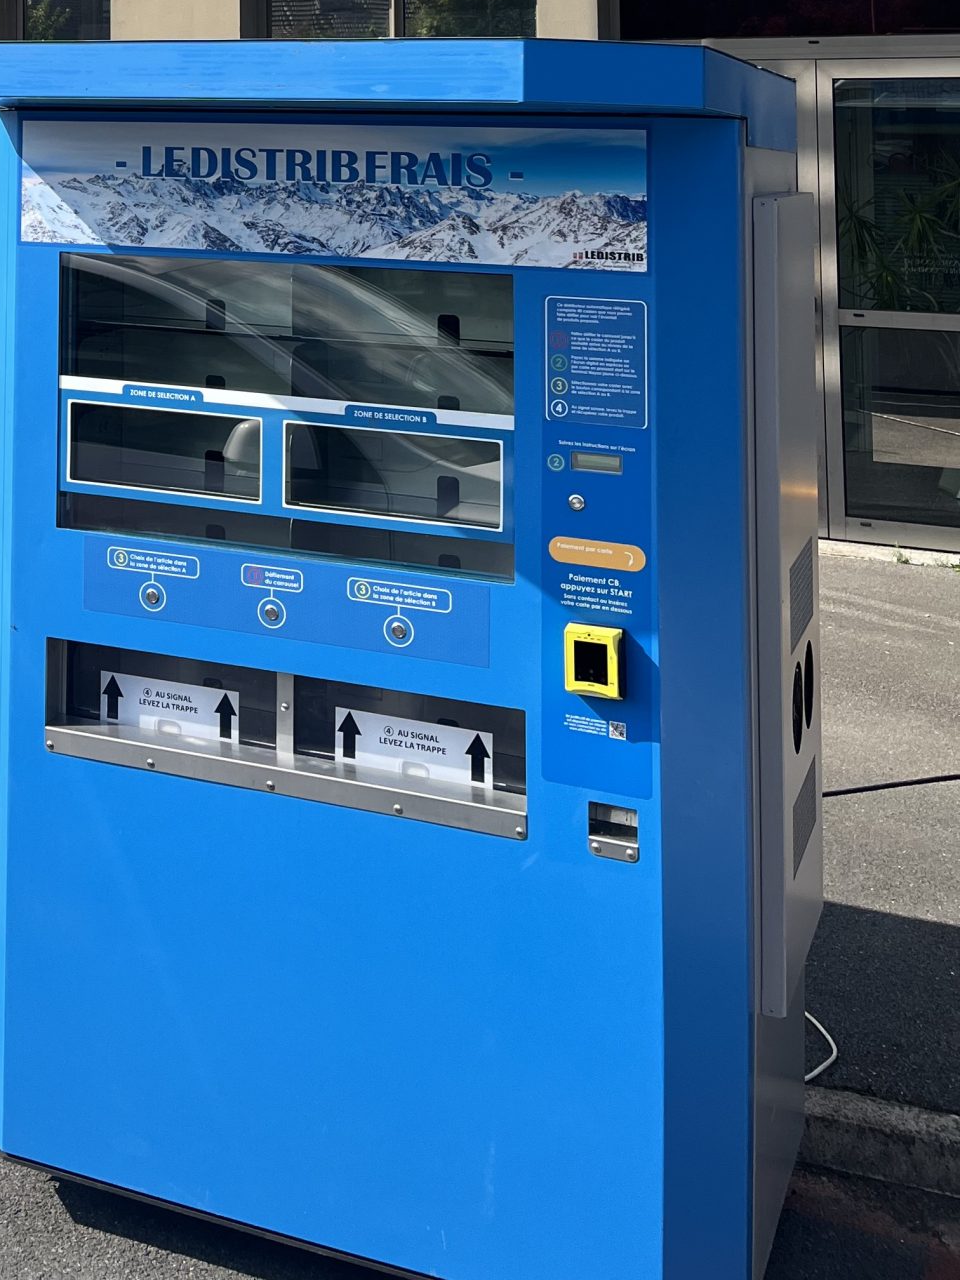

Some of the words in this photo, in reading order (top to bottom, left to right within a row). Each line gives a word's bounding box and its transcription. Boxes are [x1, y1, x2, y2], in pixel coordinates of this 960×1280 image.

[585, 251, 644, 262] LEDISTRIB
[130, 389, 146, 397] ZONE
[157, 392, 189, 400] SELECTION
[353, 410, 372, 418] ZONE
[385, 413, 420, 422] SELECTION
[568, 573, 606, 585] Paiement
[373, 585, 389, 593] Choix
[423, 592, 437, 600] dans
[560, 583, 595, 593] appuyez
[596, 587, 608, 595] sur
[610, 589, 632, 598] START
[167, 692, 192, 703] SIGNAL
[139, 698, 160, 708] LEVEZ
[171, 703, 198, 714] TRAPPE
[398, 729, 409, 738] AU
[410, 731, 440, 743] SIGNAL
[379, 737, 403, 747] LEVEZ
[405, 741, 414, 749] LA
[416, 743, 447, 755] TRAPPE
